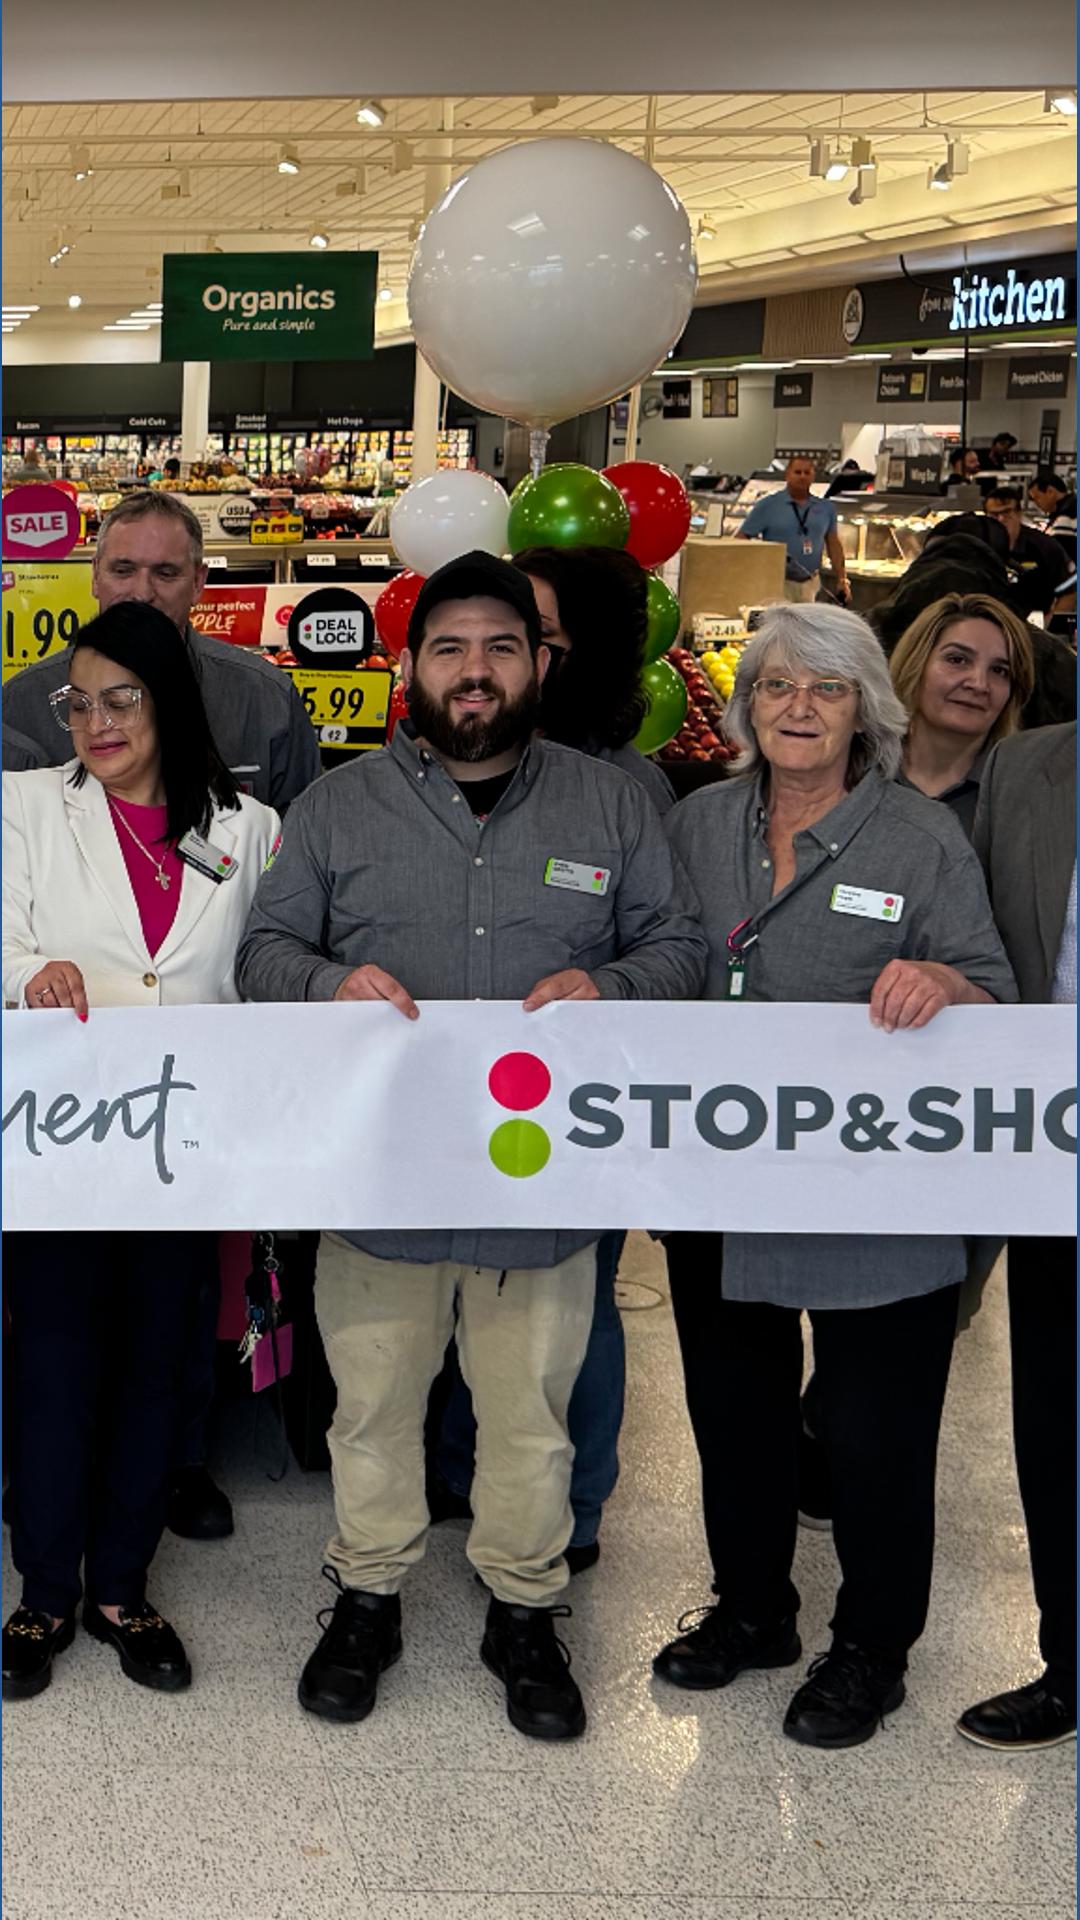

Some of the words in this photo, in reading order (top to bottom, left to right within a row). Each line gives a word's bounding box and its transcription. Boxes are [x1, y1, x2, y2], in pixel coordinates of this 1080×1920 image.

[202, 284, 336, 318] Organics
[950, 269, 1065, 330] kitchen
[222, 319, 250, 331] Pure
[252, 318, 277, 331] and
[279, 318, 316, 334] simple
[16, 421, 40, 430] Bacon
[129, 417, 147, 427] Cold
[148, 417, 166, 426] Cuts
[327, 417, 341, 425] Hot
[343, 417, 363, 426] Dogs
[226, 506, 251, 515] USDA
[10, 515, 64, 533] SALE
[217, 600, 256, 614] perfect
[189, 612, 237, 631] PPLE
[316, 618, 358, 631] DEAL
[6, 608, 79, 658] 1.99
[316, 631, 358, 645] LOCK
[302, 686, 365, 719] 5.99
